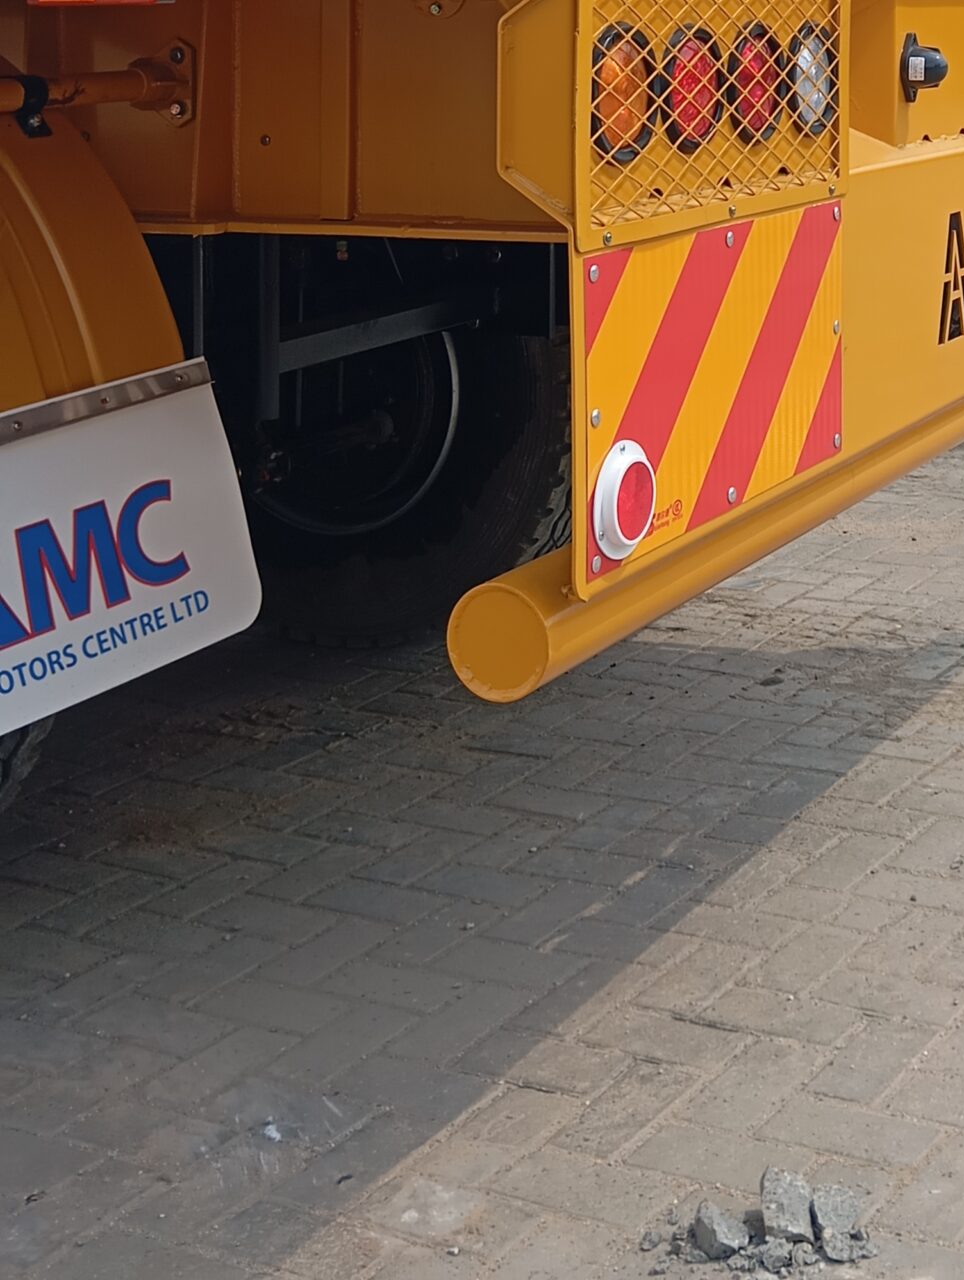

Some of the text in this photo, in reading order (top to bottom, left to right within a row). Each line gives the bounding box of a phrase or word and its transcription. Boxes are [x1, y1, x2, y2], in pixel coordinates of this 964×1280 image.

[0, 590, 209, 695] OTORS CENTRE LTD
